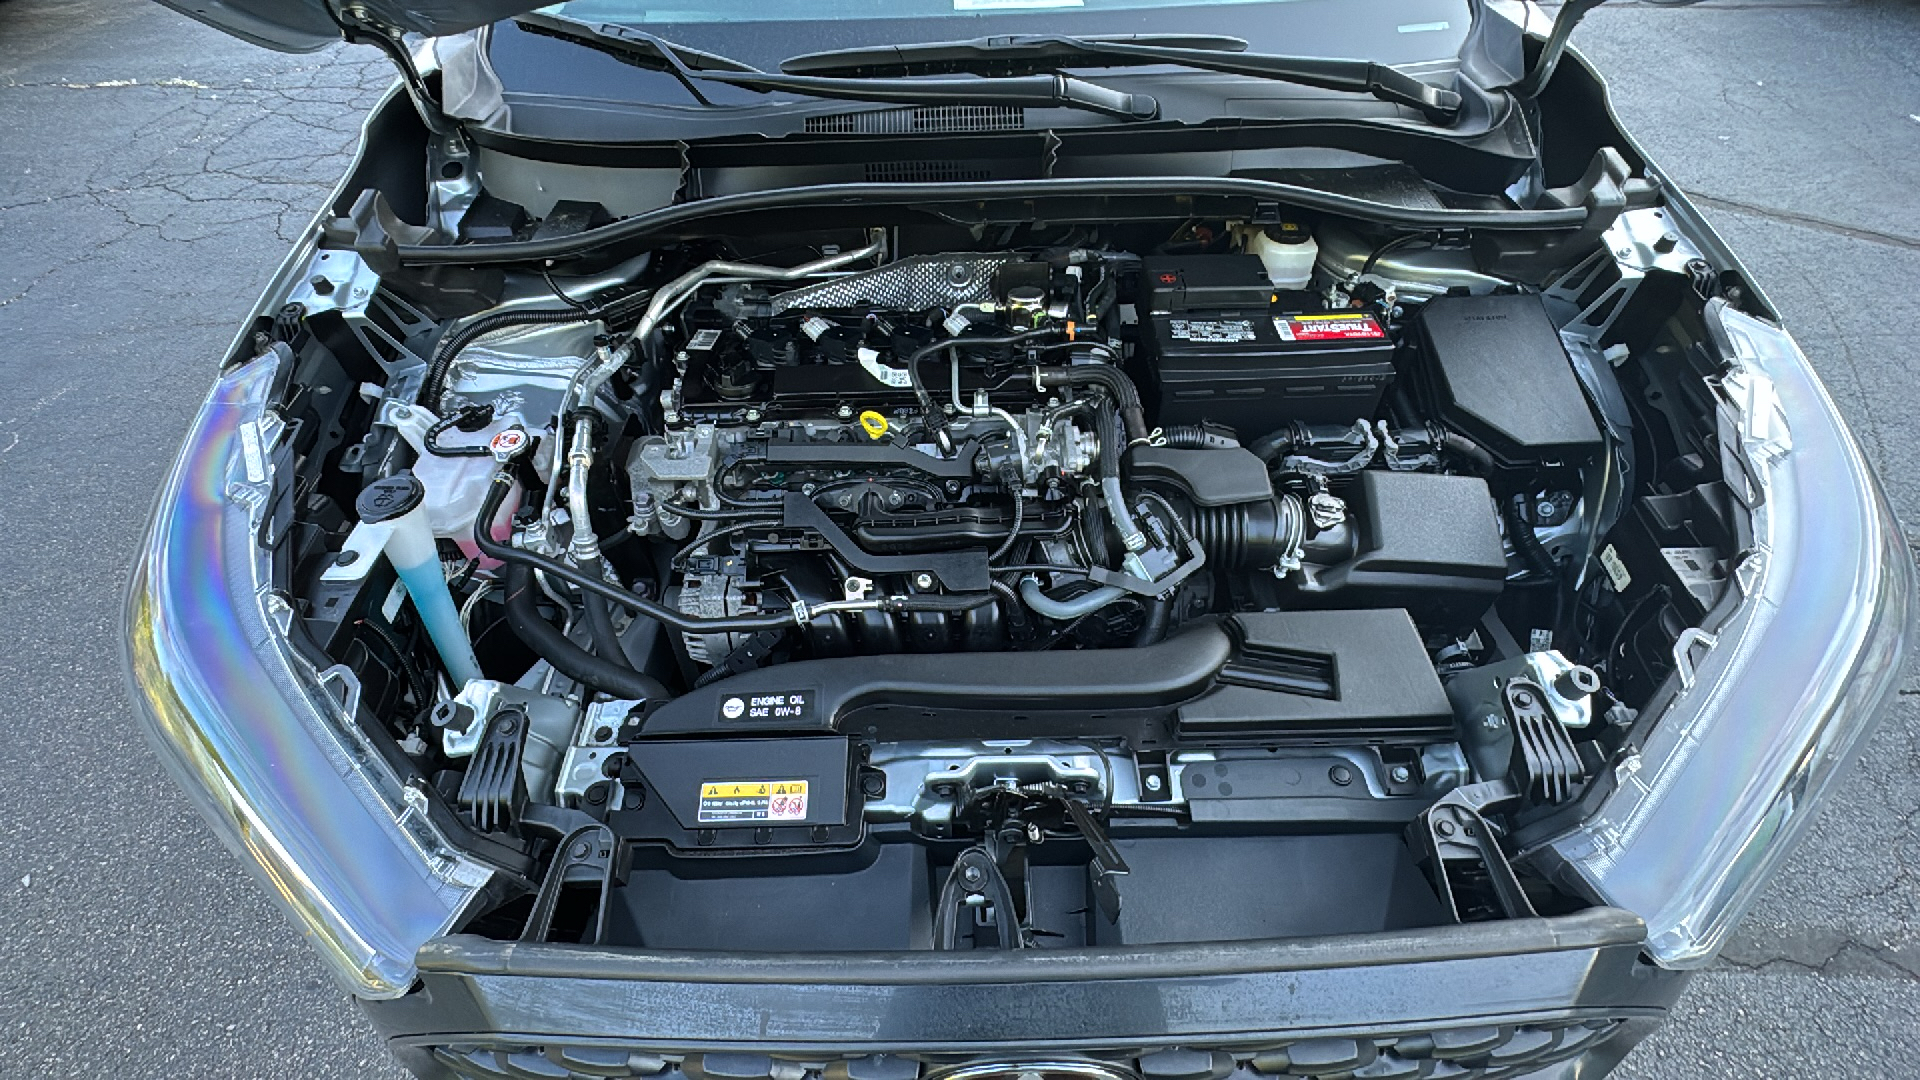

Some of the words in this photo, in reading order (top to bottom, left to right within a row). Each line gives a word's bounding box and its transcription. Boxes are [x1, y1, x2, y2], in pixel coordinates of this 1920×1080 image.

[751, 696, 784, 706] ENGINE
[789, 695, 804, 704] OIL
[749, 707, 769, 717] SAE
[775, 706, 801, 716] 0W-8
